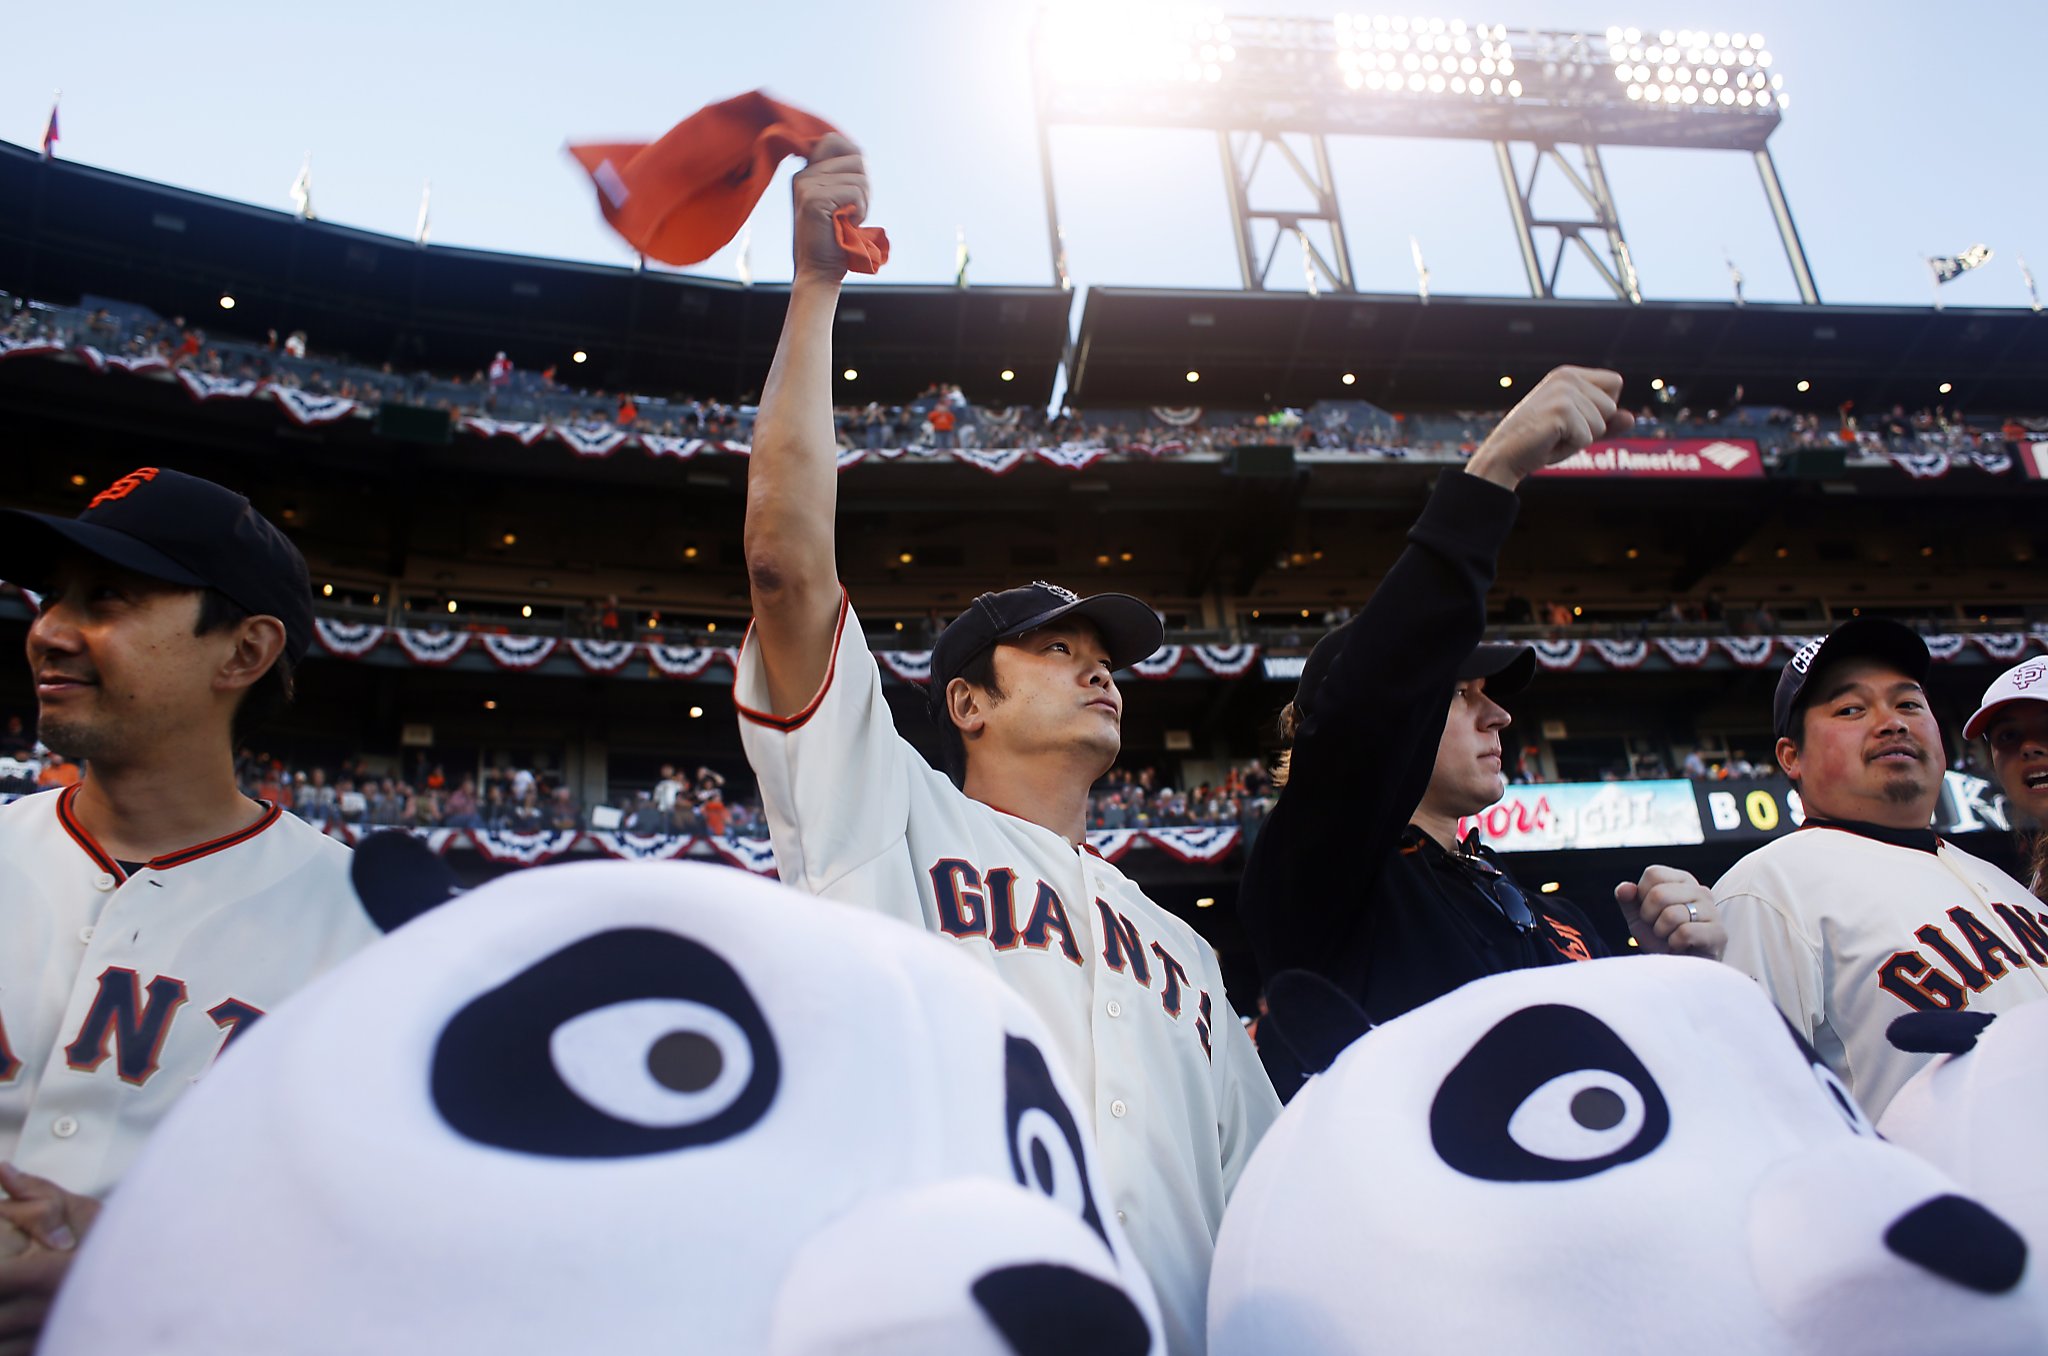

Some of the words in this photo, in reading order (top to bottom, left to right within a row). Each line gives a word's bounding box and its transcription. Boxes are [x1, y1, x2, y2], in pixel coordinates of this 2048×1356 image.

[1544, 449, 1594, 470] nk
[1594, 448, 1617, 471] of
[1617, 448, 1700, 471] America
[1877, 902, 2048, 1012] GIAN
